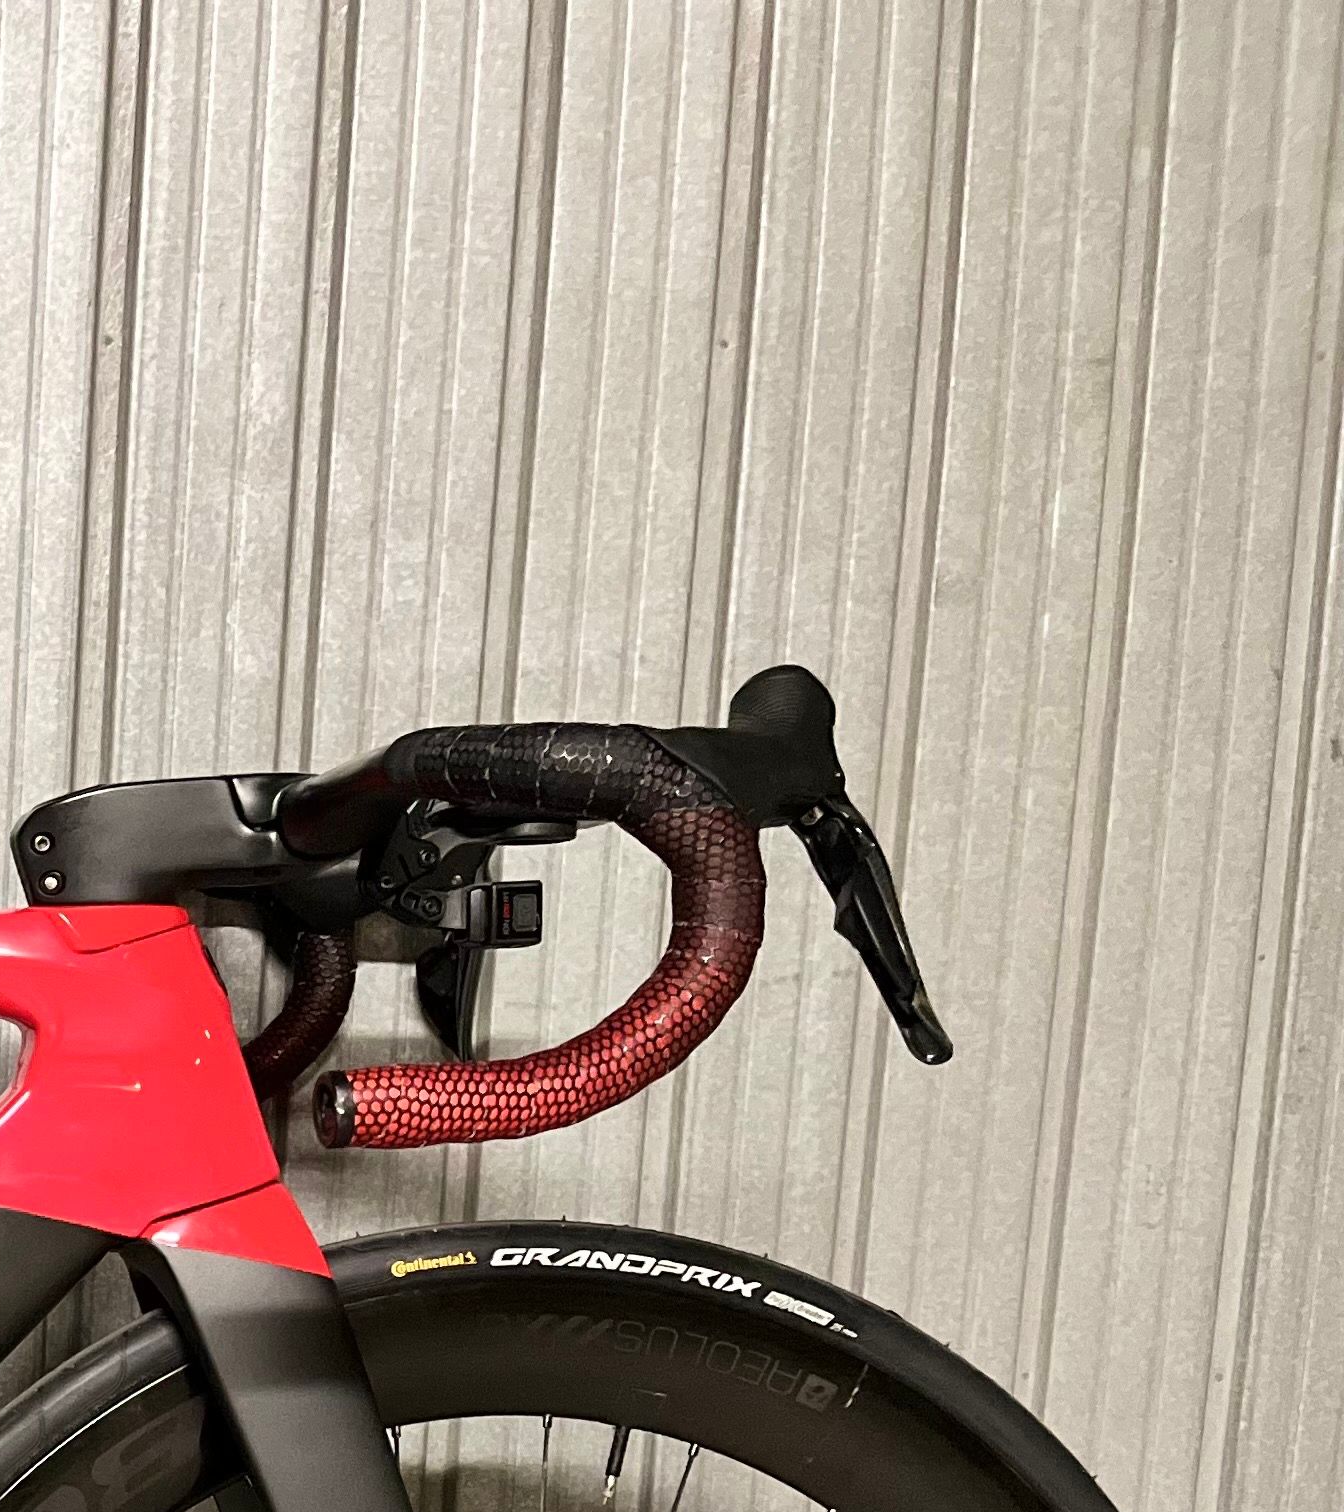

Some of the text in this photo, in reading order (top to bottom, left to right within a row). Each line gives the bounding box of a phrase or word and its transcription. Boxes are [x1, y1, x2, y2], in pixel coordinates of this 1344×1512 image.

[390, 1247, 762, 1298] Continental GRANDPRIX
[613, 1319, 802, 1398] AEOLUS
